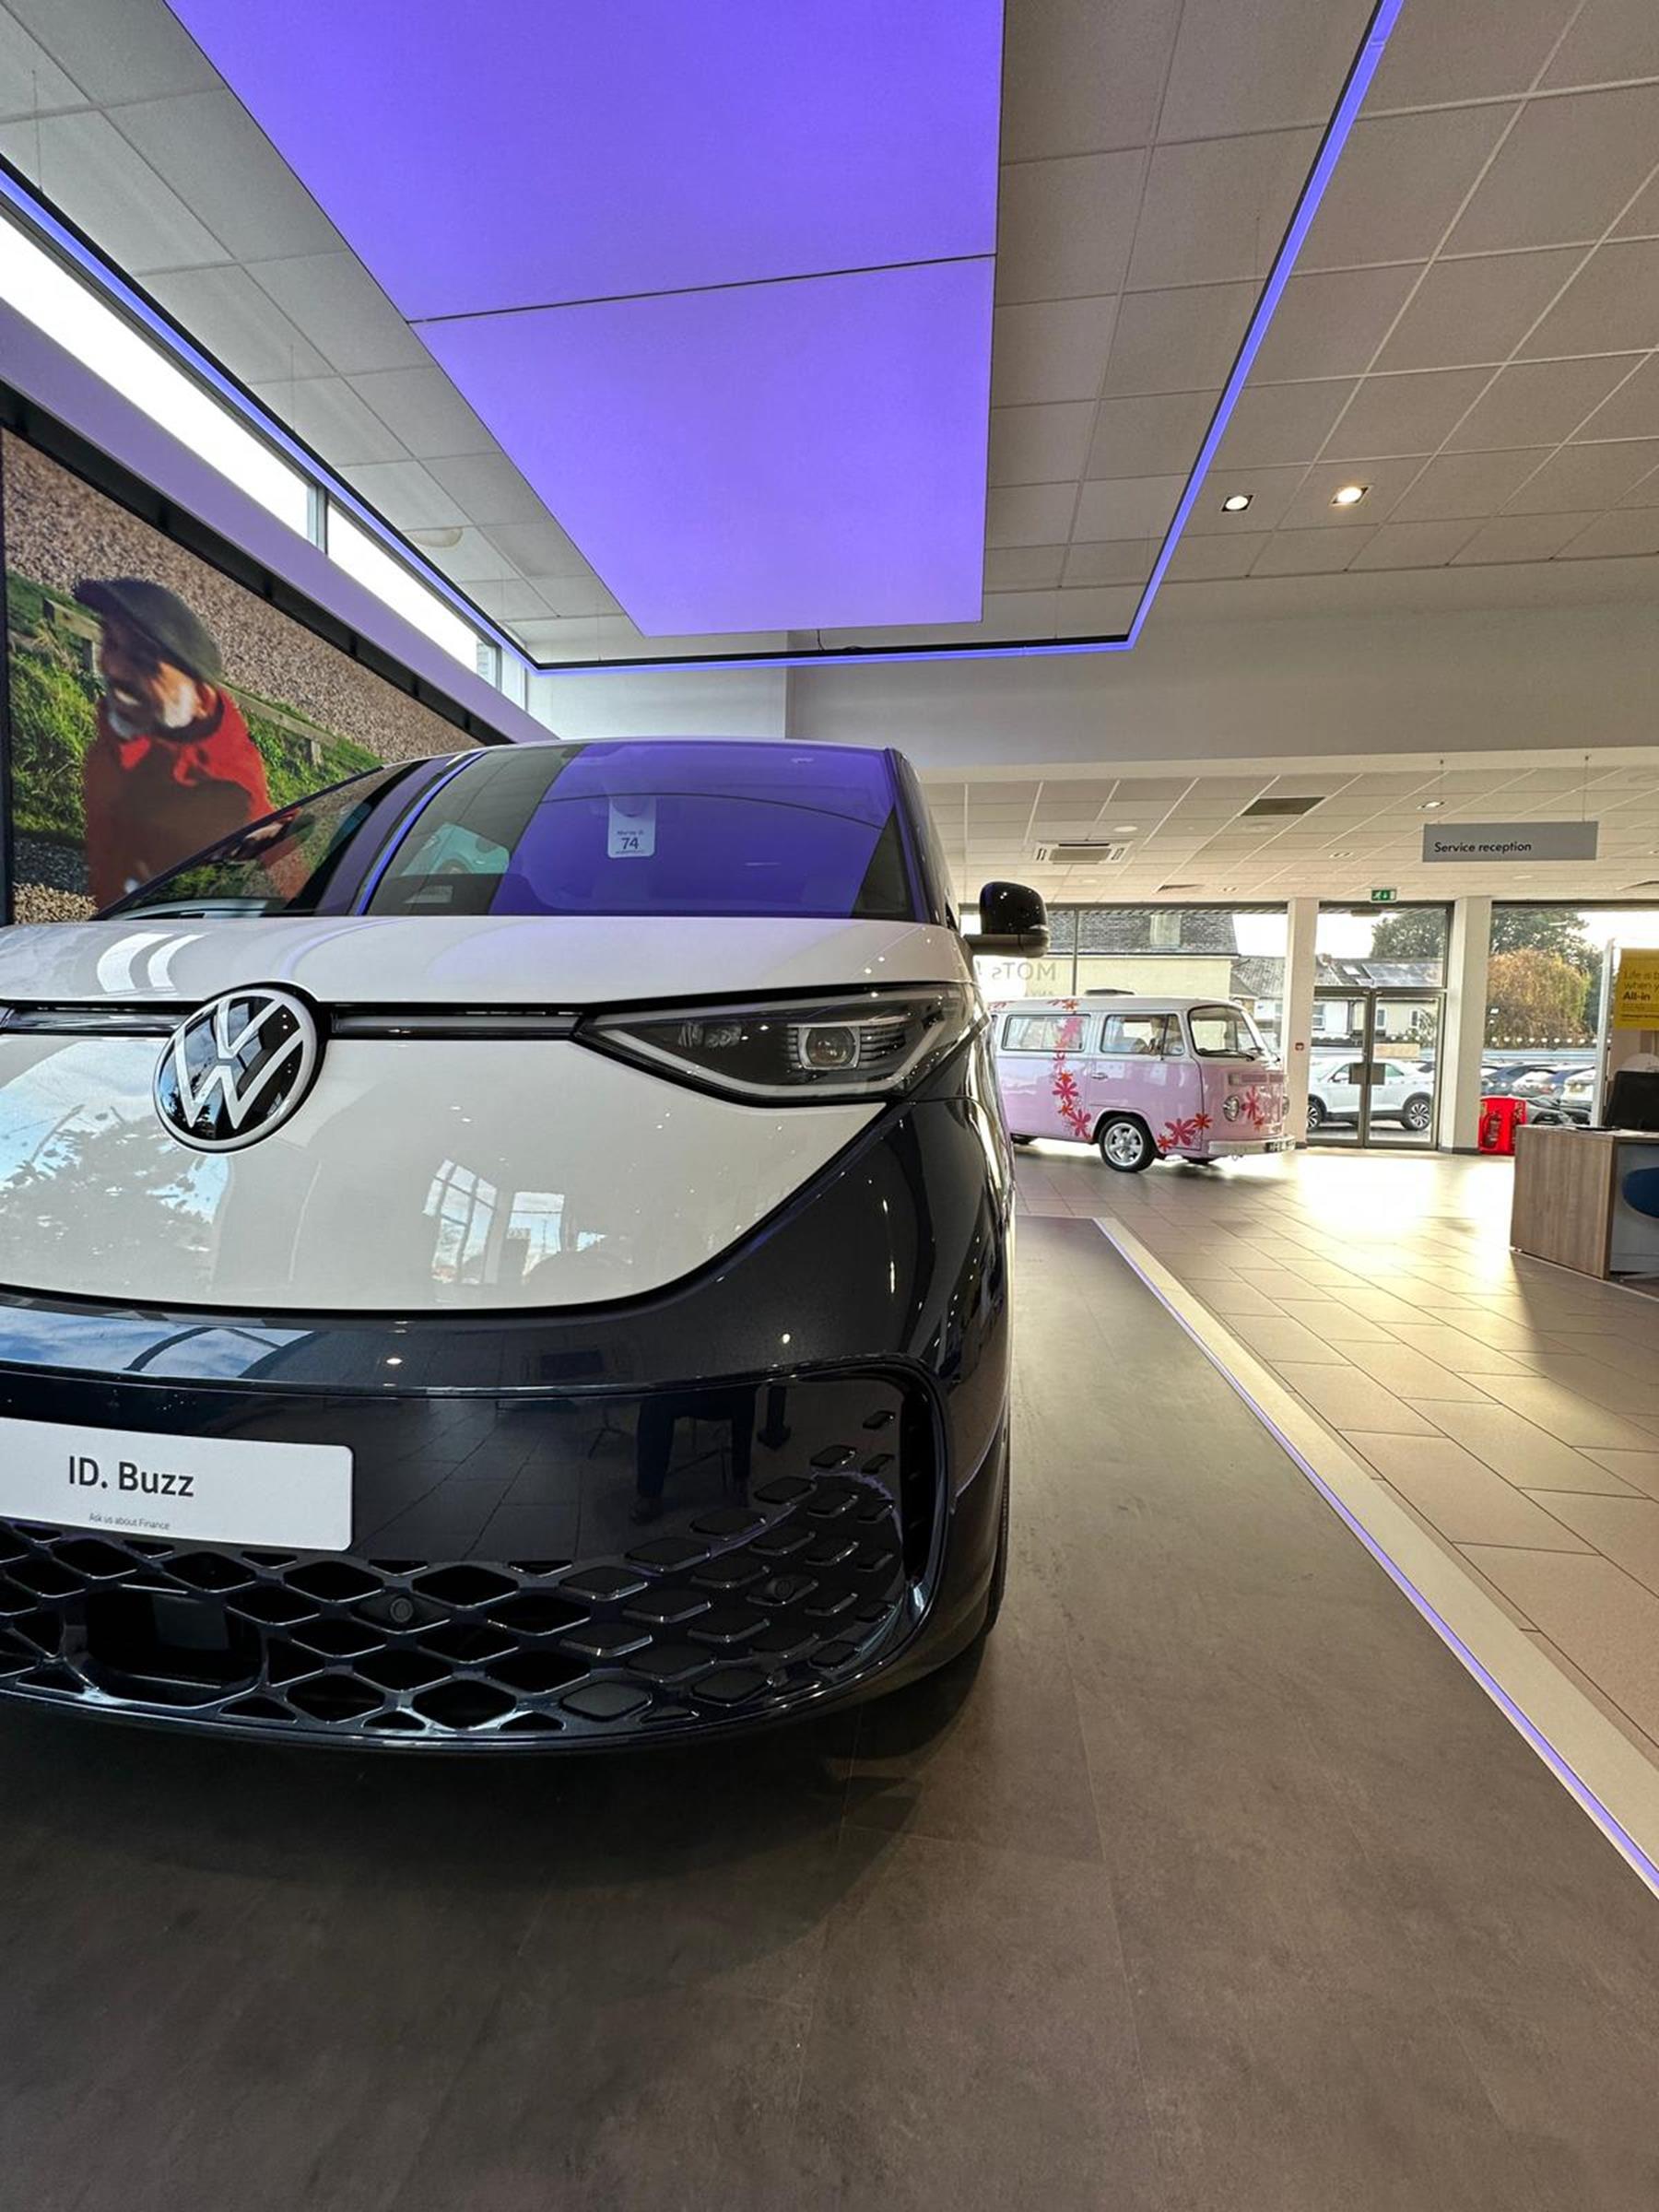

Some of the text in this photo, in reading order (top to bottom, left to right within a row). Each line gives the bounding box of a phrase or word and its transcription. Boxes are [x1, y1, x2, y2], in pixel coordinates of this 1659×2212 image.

[620, 837, 640, 850] 74
[1434, 841, 1532, 853] Service reception
[1622, 990, 1651, 1001] All-in
[69, 1455, 194, 1498] ID. Buzz
[89, 1512, 171, 1530] Ask us about Finance
